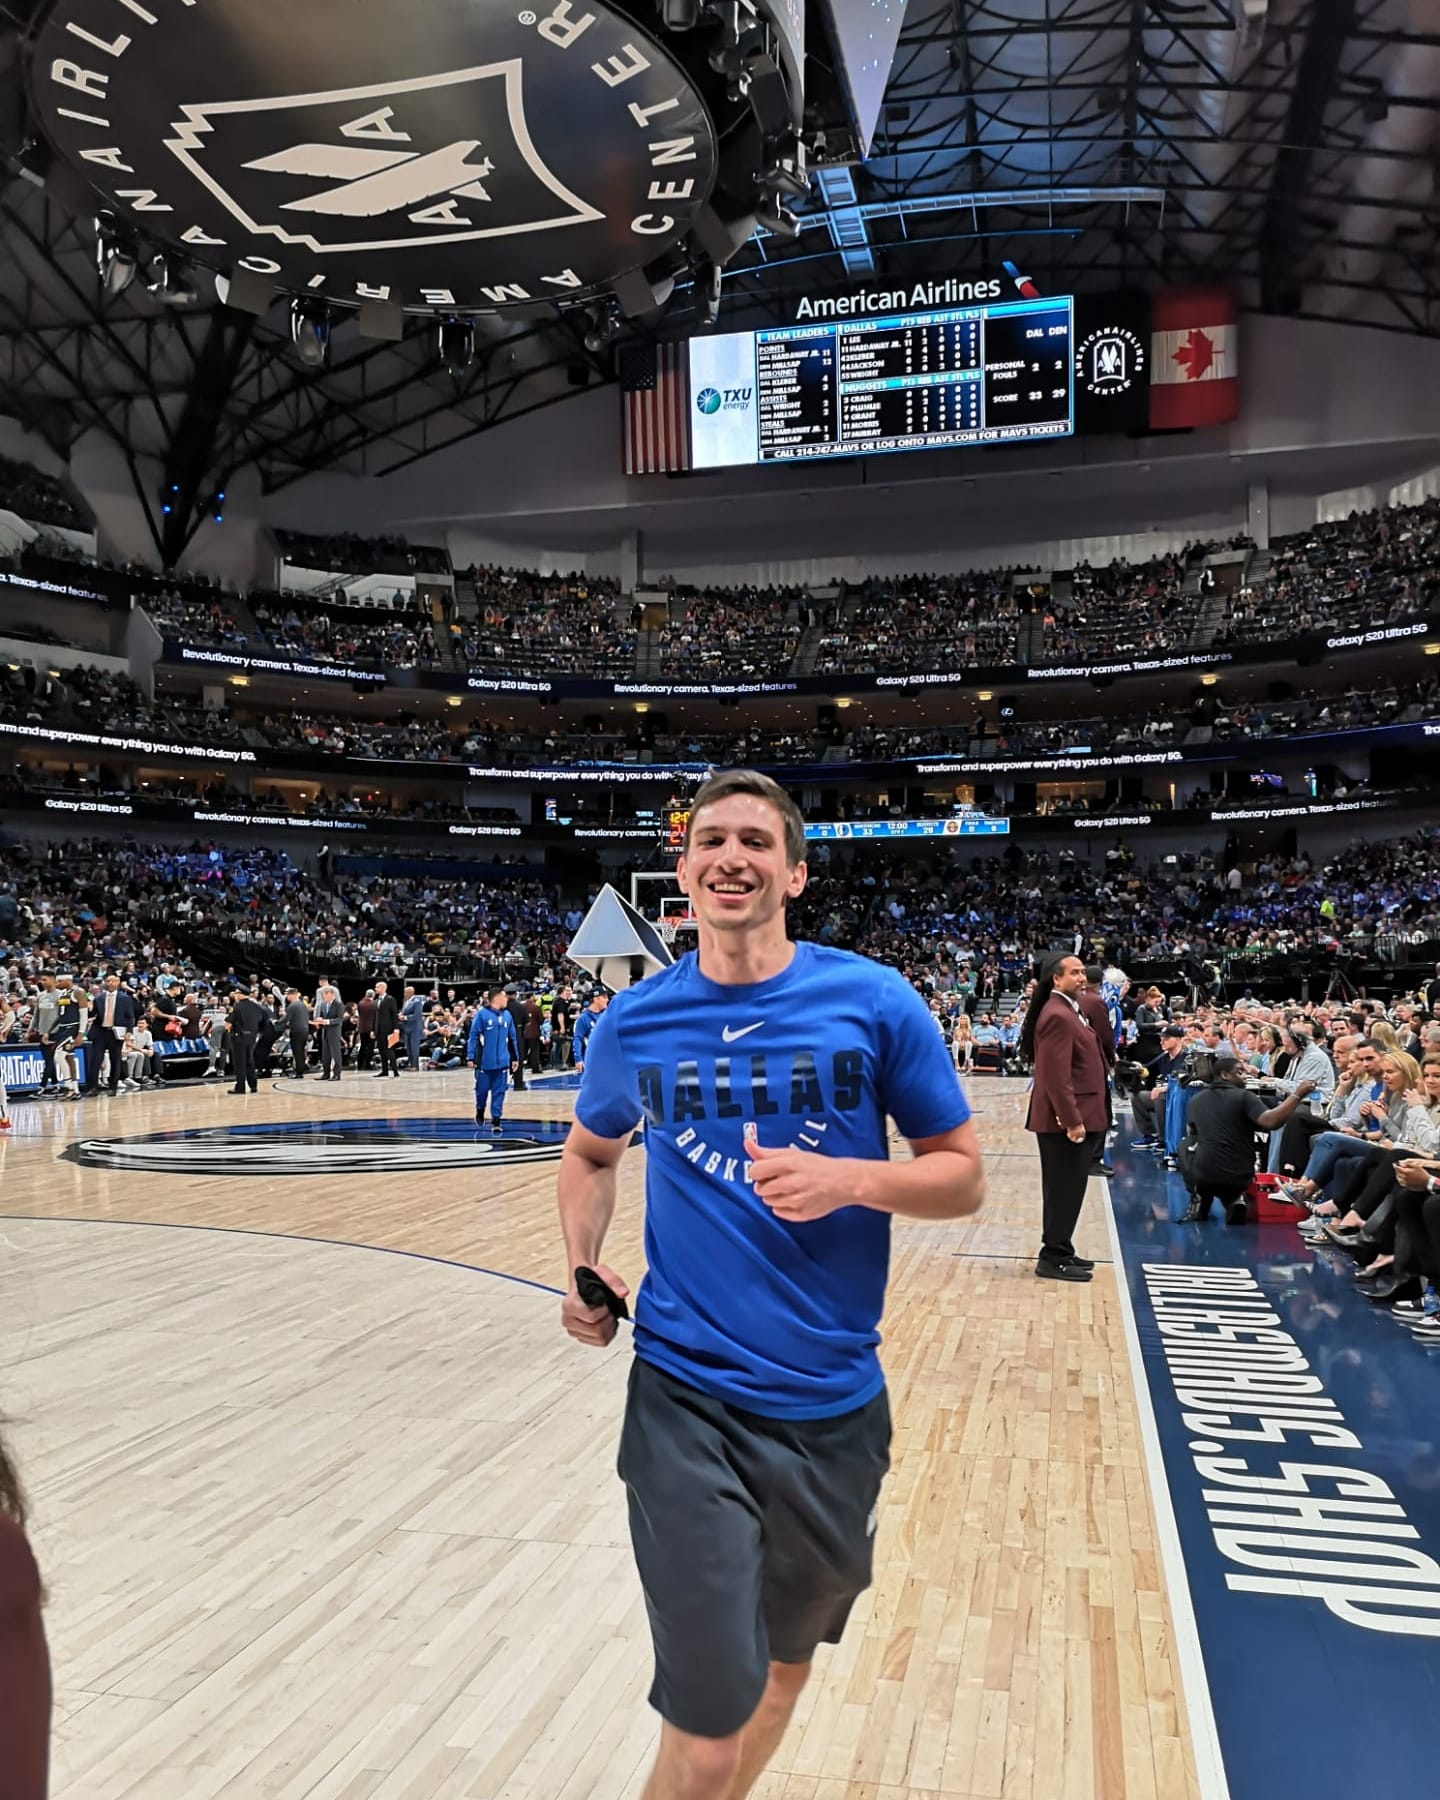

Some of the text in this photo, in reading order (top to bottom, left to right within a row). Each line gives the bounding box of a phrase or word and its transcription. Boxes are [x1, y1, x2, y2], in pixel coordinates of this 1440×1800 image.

[537, 0, 697, 235] CENTER
[52, 0, 583, 304] AMERICAN AIRLI
[796, 278, 1001, 319] American Airlines
[844, 322, 877, 333] DALLAS
[902, 318, 915, 326] PTS
[934, 314, 948, 322] AST
[951, 312, 964, 320] STL
[769, 328, 828, 340] TEAM LEADERS
[1026, 326, 1067, 338] DAL DEN
[849, 360, 884, 370] JACKSON
[985, 360, 1062, 372] PERSONAL 2 2
[993, 371, 1017, 380] FOULS
[845, 381, 887, 392] NUGGETS
[1087, 379, 1131, 395] CENTER
[723, 387, 752, 402] TXU
[850, 395, 873, 403] CRAIG
[993, 388, 1066, 403] SCORE 33 29
[723, 401, 750, 410] energy
[774, 449, 795, 458] CALL
[861, 442, 874, 450] OR
[876, 440, 895, 449] LOG
[897, 437, 924, 447] ONTO
[926, 432, 977, 445] MAVS.COM
[979, 430, 998, 439] FOR
[1000, 428, 1027, 438] MAVS
[1029, 424, 1065, 435] TICKETS
[1327, 623, 1428, 648] Galaxy S20 Ultra 5G
[183, 649, 250, 668] Revolutionary
[292, 663, 345, 678] Texas-sized
[1028, 665, 1091, 677] Revolutionary
[1132, 656, 1188, 670] Texas-sized
[468, 678, 552, 691] Galaxy S20 Ultra 5G
[876, 673, 961, 687] Galaxy S20 Ultra 5G
[614, 683, 671, 695] Revolutionary
[711, 684, 760, 693] Texas-sized
[18, 726, 40, 736] and
[40, 728, 100, 743] superpower
[101, 736, 153, 752] everything
[153, 742, 170, 753] you
[170, 745, 183, 754] do
[184, 746, 206, 757] with
[206, 749, 240, 762] Galaxy
[917, 763, 960, 773] Transform
[961, 762, 979, 771] and
[979, 761, 1033, 772] superpower
[1033, 757, 1081, 770] everything
[1082, 758, 1099, 768] you
[1100, 756, 1112, 765] do
[1113, 754, 1133, 765] with
[1134, 753, 1167, 764] Galaxy
[469, 767, 511, 777] Transform
[512, 769, 529, 778] and
[530, 771, 580, 781] superpower
[581, 771, 624, 782] everything
[625, 772, 641, 782] you
[641, 771, 653, 780] do
[45, 800, 133, 813] Galaxy S20 Ultra 5G
[1211, 809, 1270, 820] Revolutionary
[1309, 801, 1360, 814] Texas-sized
[194, 811, 251, 824] Revolutionary
[288, 817, 333, 828] Texas-sized
[1074, 815, 1151, 829] Galaxy S20 Ultra 5G
[575, 828, 625, 838] Revolutionary
[676, 1119, 828, 1184] BASKELL
